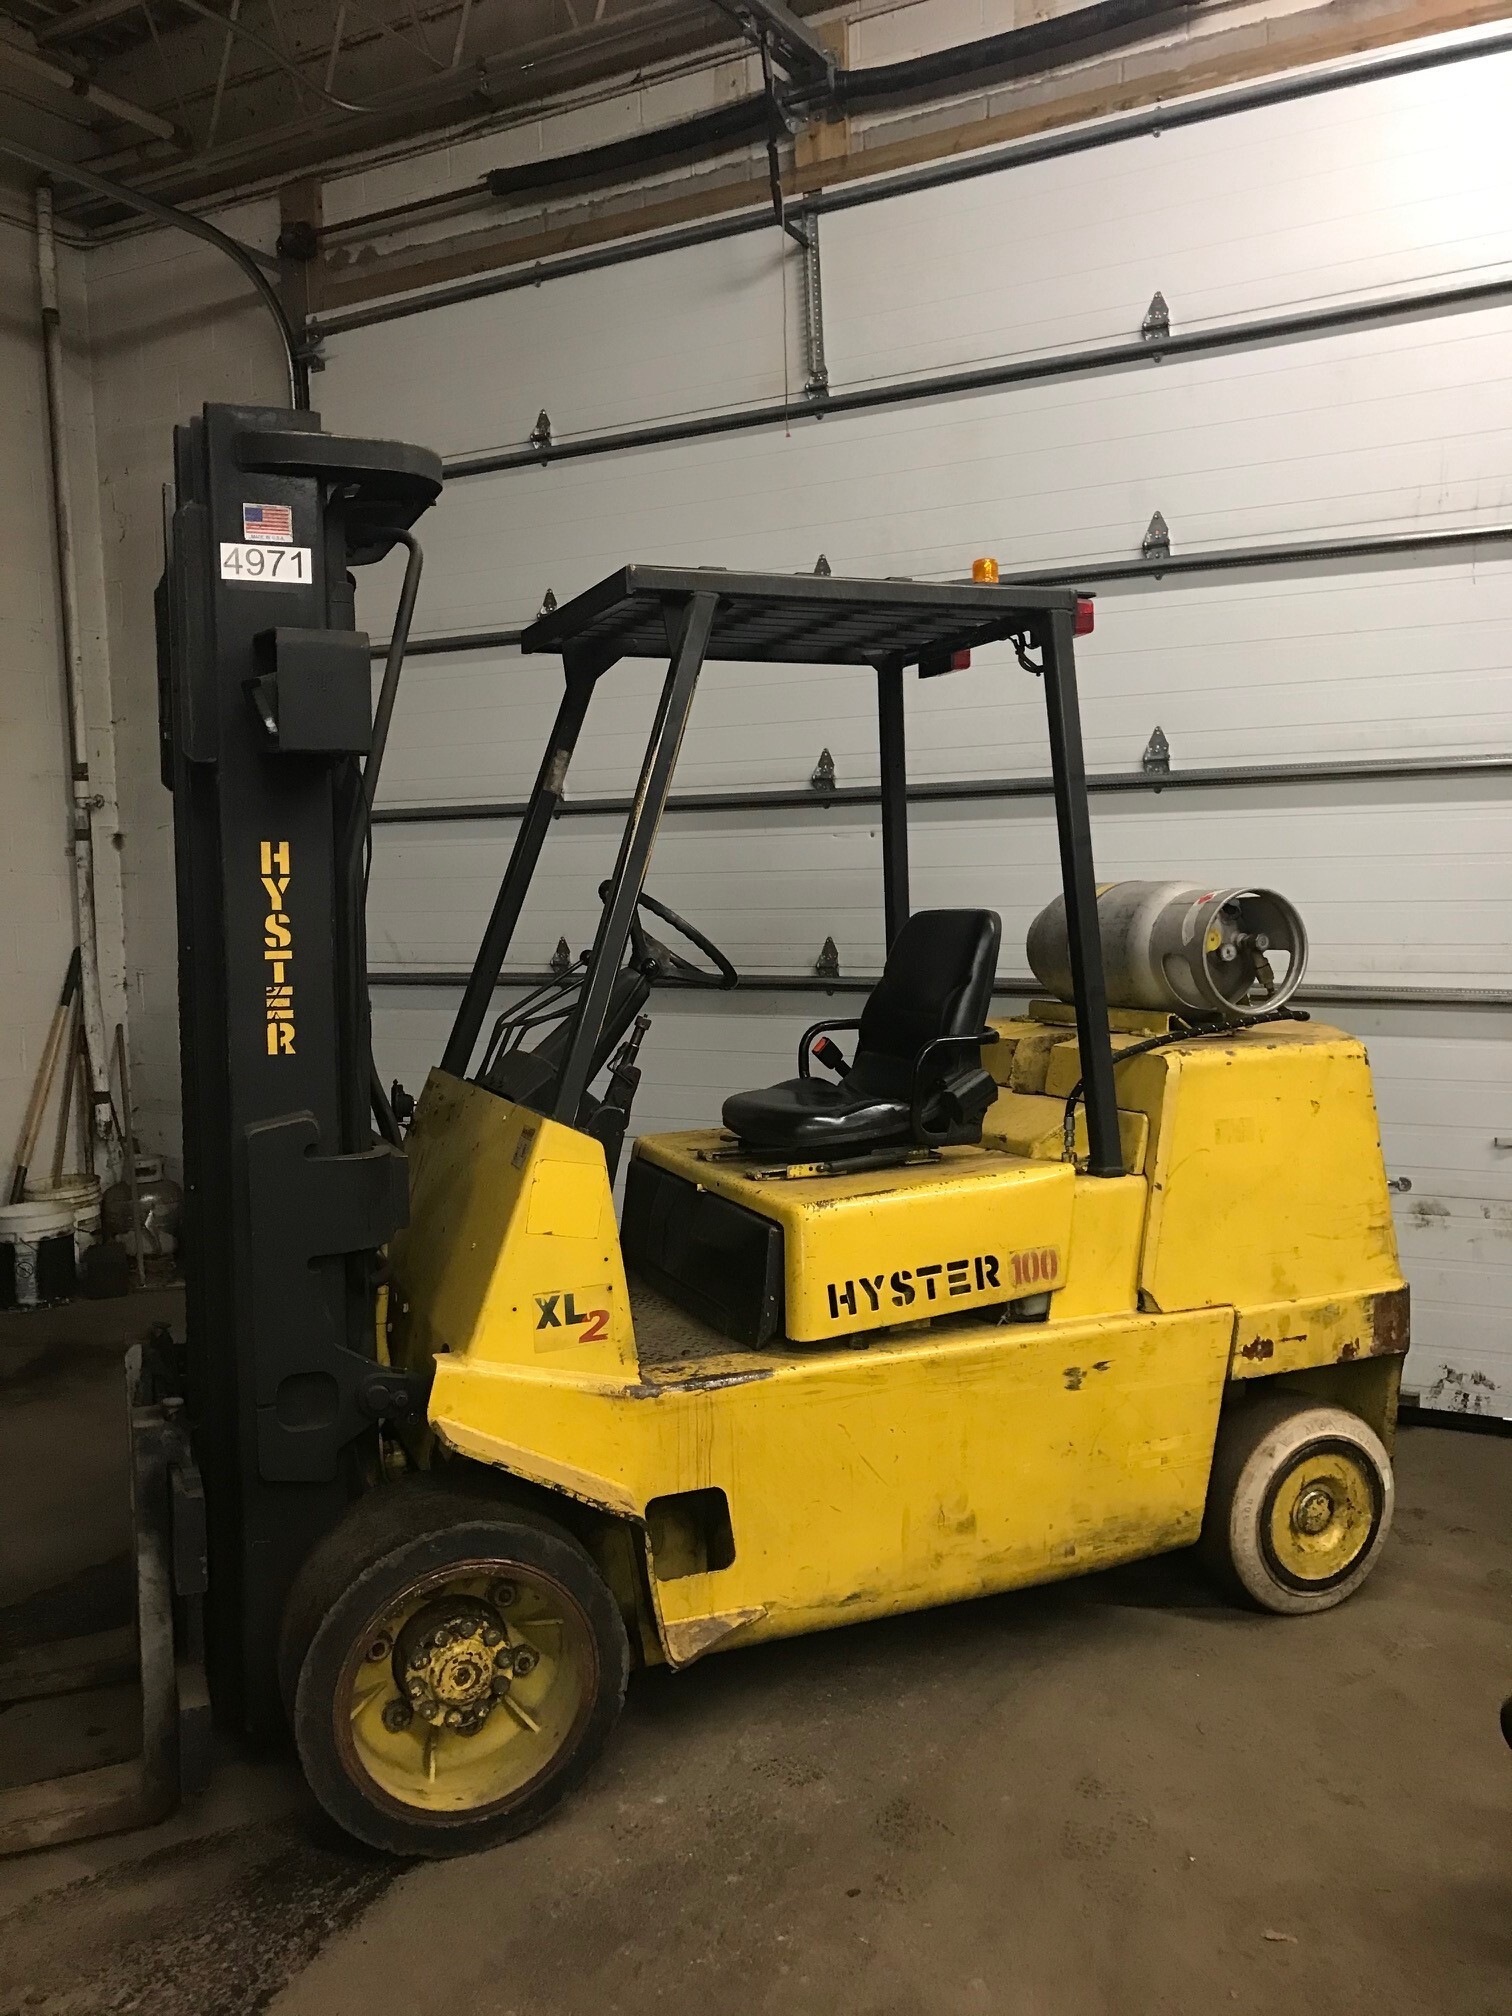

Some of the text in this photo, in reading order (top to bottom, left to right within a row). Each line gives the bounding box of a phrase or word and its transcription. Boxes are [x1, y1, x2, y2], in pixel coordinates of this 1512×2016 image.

[223, 547, 303, 579] 4971
[260, 841, 296, 1055] HYSTER
[827, 1248, 1058, 1319] HYSTER 100
